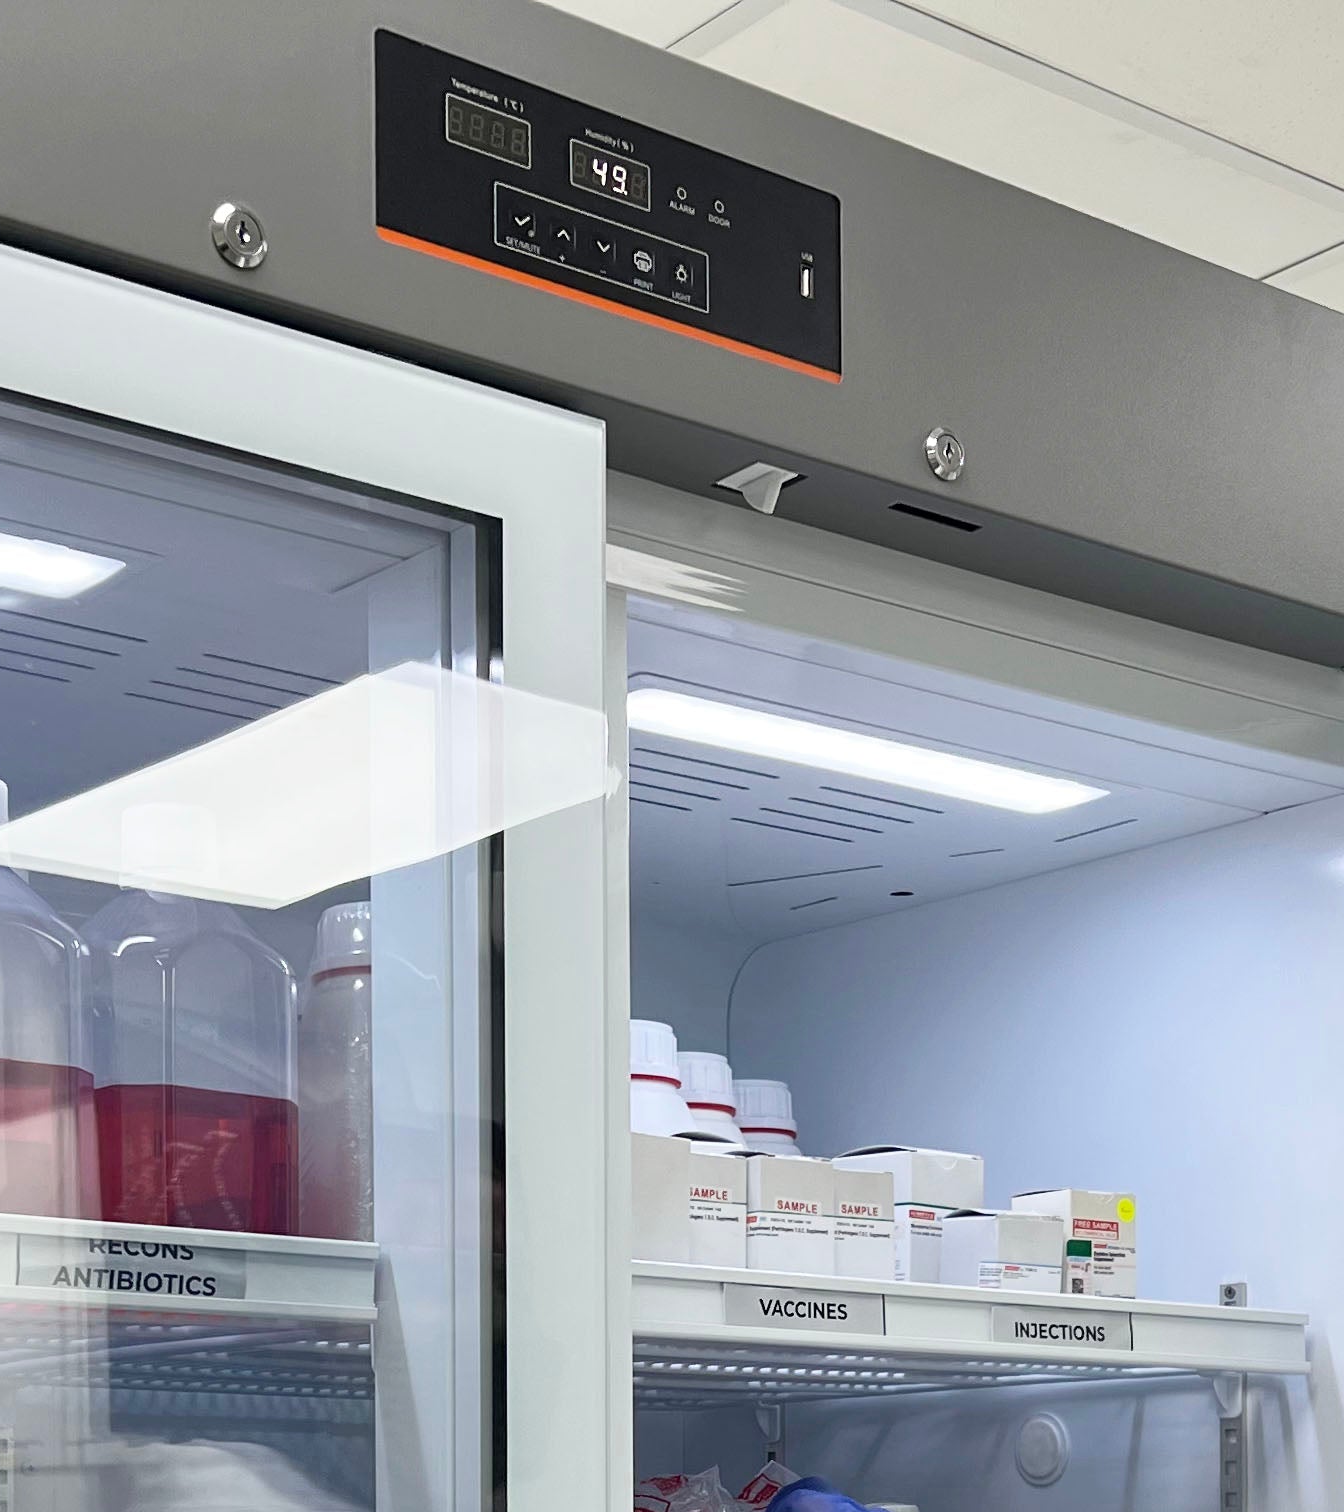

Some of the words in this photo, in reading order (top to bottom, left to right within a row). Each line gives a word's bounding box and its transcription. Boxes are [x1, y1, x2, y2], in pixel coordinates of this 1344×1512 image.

[669, 200, 696, 216] ALARM
[708, 214, 731, 229] DOOR
[777, 1200, 817, 1214] SAMPLE
[841, 1204, 879, 1216] SAMPLE
[52, 1266, 216, 1297] ANTIBIOTICS
[759, 1298, 848, 1320] VACCINES
[1014, 1321, 1105, 1342] INJECTIONS
